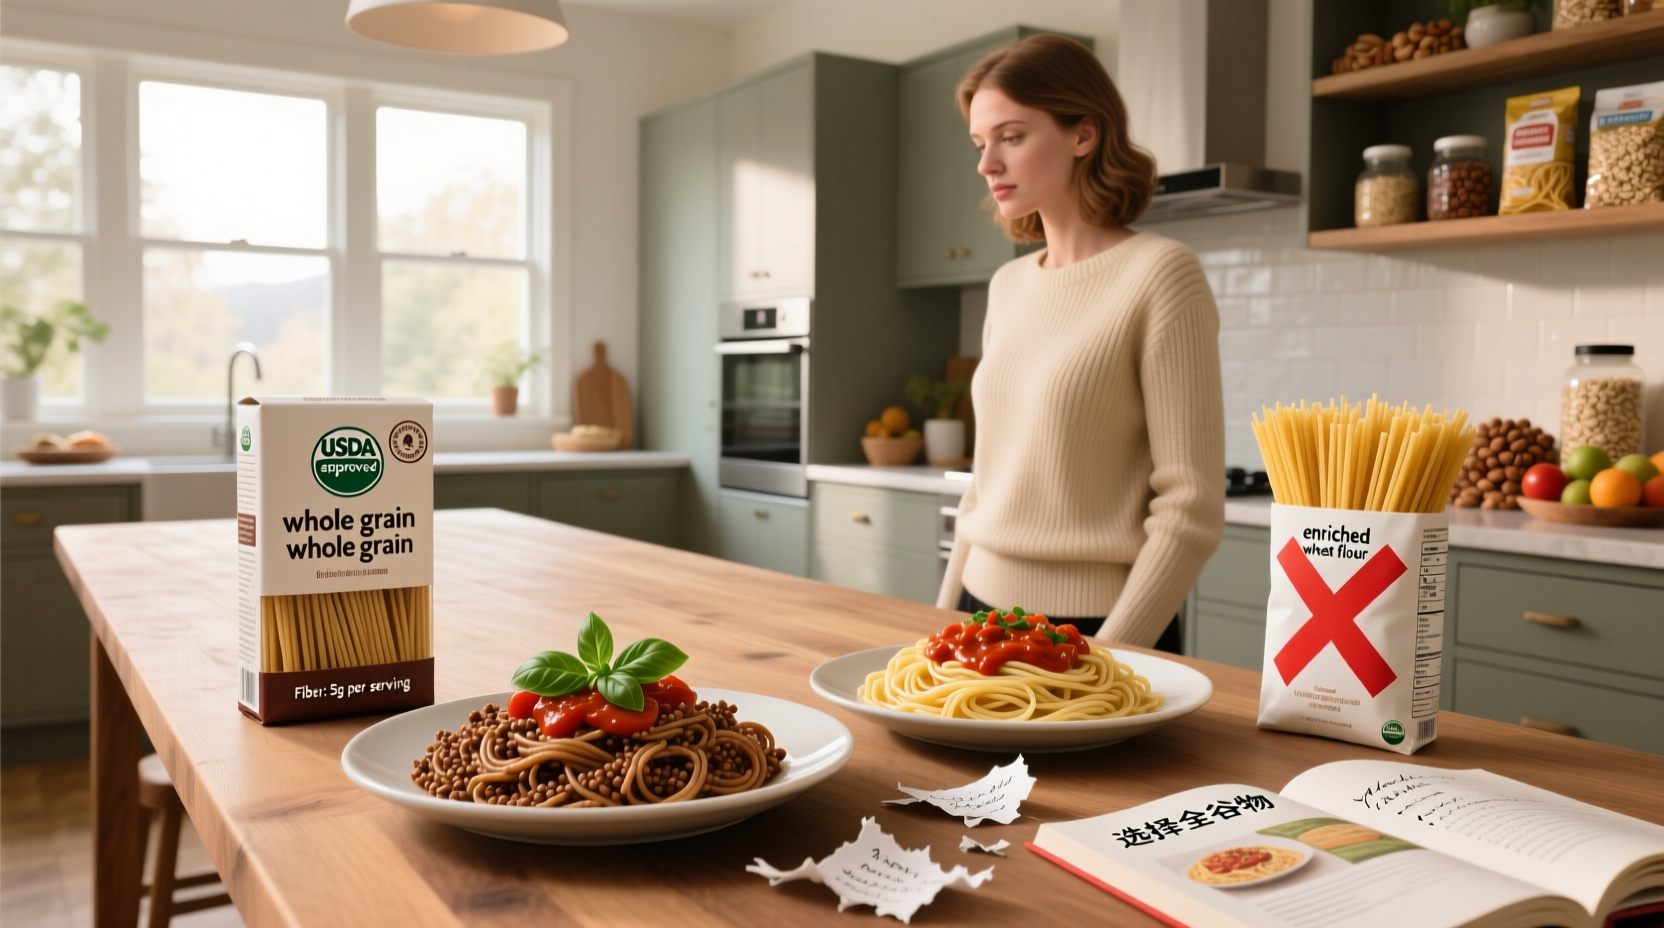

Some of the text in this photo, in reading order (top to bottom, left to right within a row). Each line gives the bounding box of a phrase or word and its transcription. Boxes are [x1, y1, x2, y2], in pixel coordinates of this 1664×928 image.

[321, 437, 376, 457] USDA
[283, 508, 354, 533] whole
[360, 506, 415, 537] grain
[1303, 524, 1371, 544] enriched
[286, 533, 413, 563] whole grain
[1338, 543, 1369, 560] flour
[330, 683, 344, 699] 5g
[348, 683, 366, 698] per
[370, 676, 411, 692] serving
[1112, 794, 1275, 848] 选择全谷物
